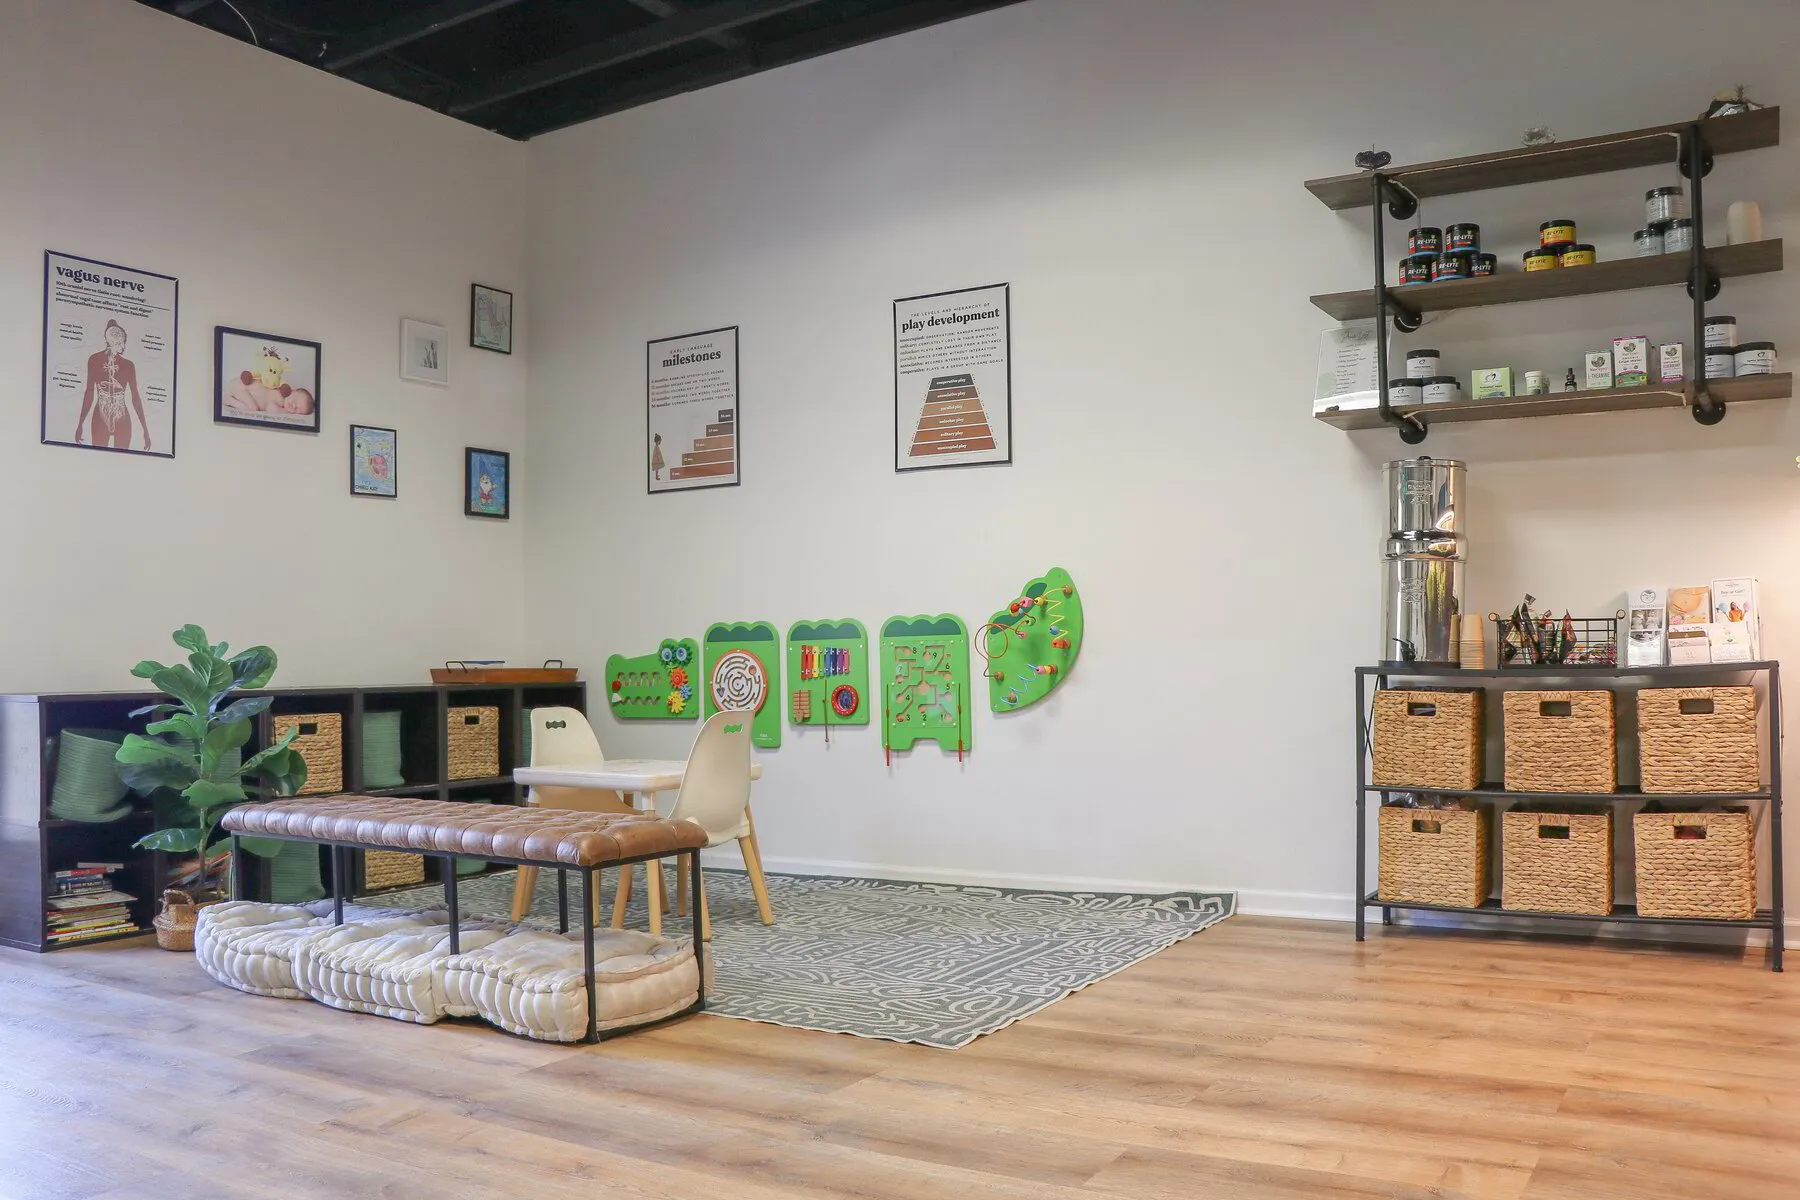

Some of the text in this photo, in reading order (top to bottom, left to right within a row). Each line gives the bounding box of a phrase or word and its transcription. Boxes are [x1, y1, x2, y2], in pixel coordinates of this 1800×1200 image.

[56, 266, 145, 293] vagus nerve
[902, 308, 1000, 333] play development
[687, 343, 713, 351] LANGUAGE
[662, 350, 722, 368] milestones
